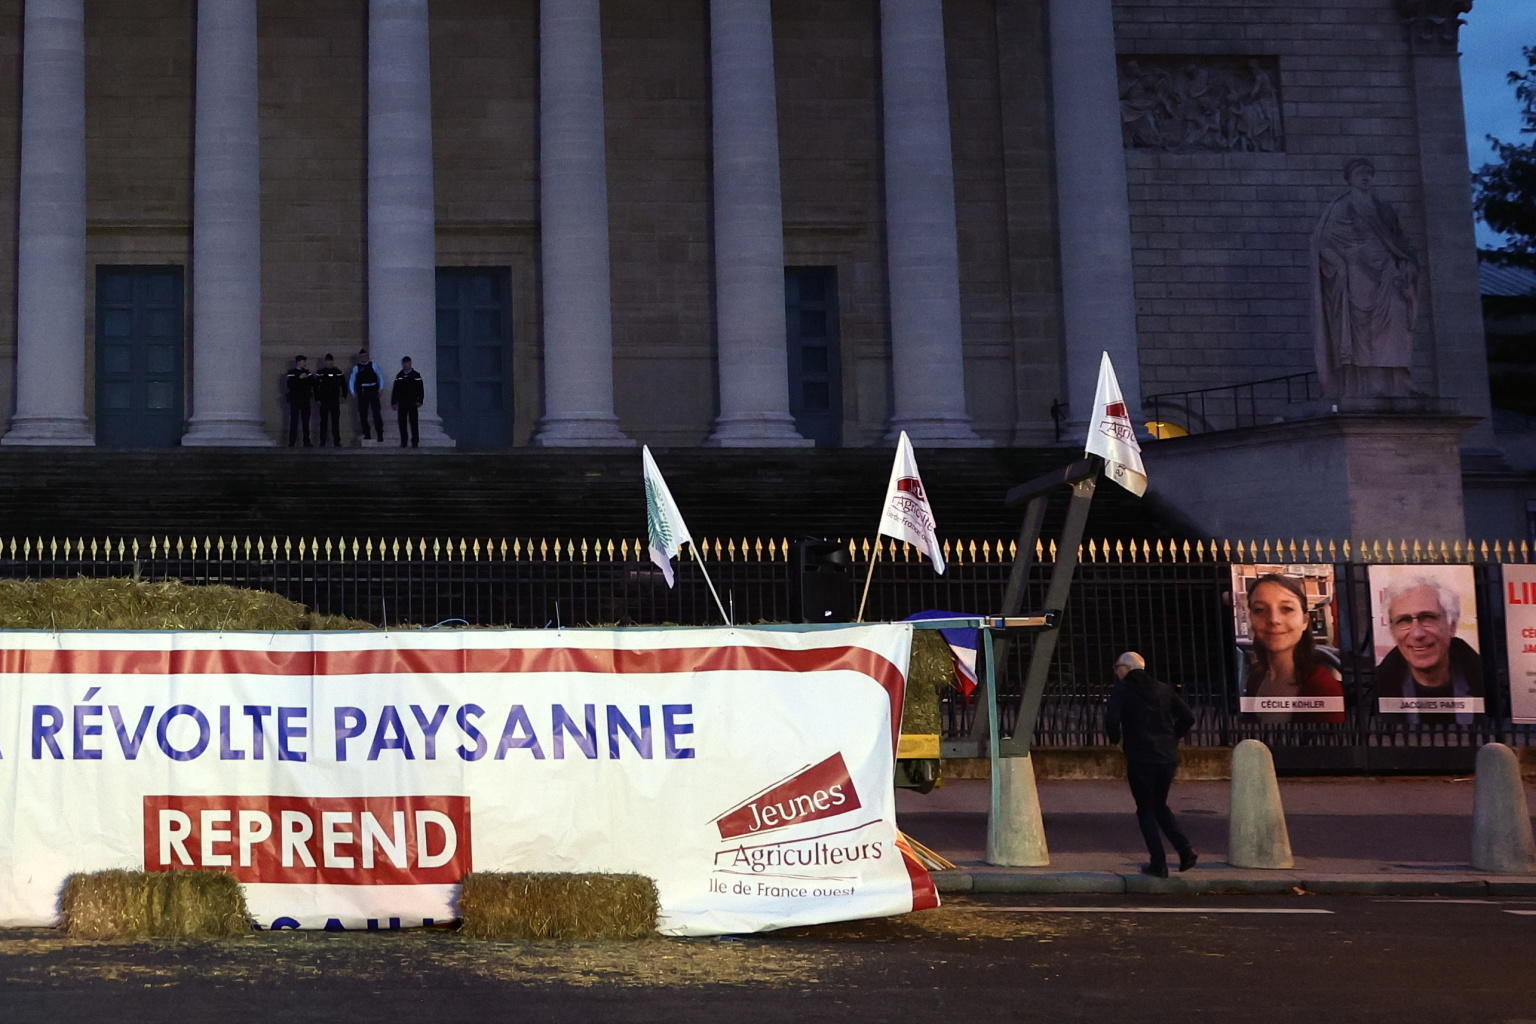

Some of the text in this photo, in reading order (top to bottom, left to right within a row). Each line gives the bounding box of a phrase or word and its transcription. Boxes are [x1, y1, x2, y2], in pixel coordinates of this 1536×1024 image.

[31, 686, 308, 762] RÉVOLTE
[335, 702, 696, 762] PAYSANNE
[1260, 699, 1290, 709] CÉCILE
[748, 784, 846, 832] Jeunes
[159, 808, 458, 869] REPREND
[732, 841, 883, 873] Agriculteurs
[733, 880, 752, 896] de
[757, 883, 808, 898] France
[813, 886, 856, 897] ouest
